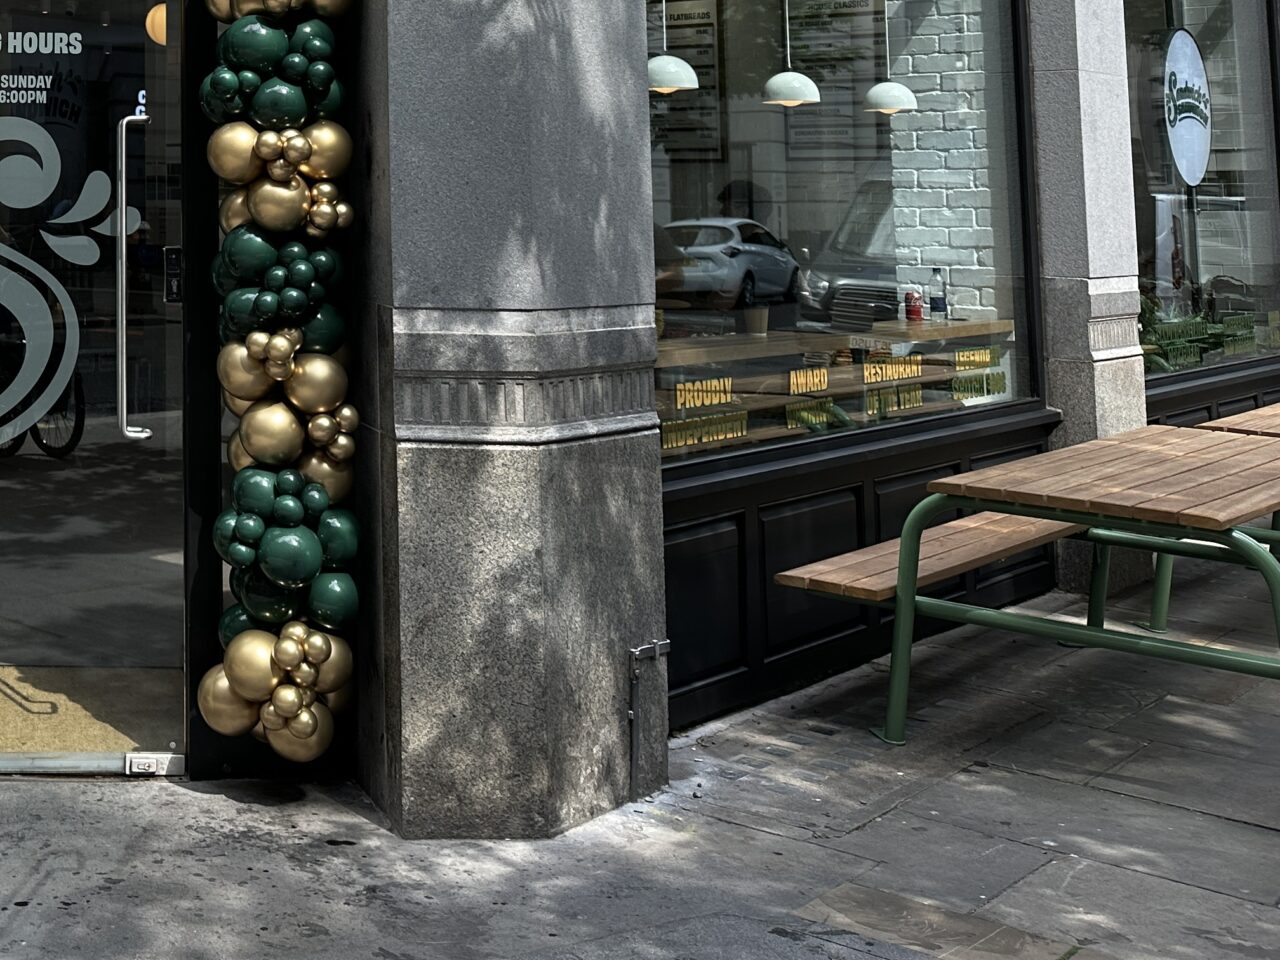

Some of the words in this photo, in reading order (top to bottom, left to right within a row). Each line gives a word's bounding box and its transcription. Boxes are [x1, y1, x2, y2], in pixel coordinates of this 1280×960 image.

[834, 0, 870, 10] CLASSICS
[7, 31, 83, 55] HOURS
[0, 74, 53, 89] SUNDAY
[789, 367, 829, 395] AWARD
[863, 354, 923, 385] RESTAURANT
[676, 377, 733, 410] PROUDLY
[662, 410, 748, 450] INDEPENDENT
